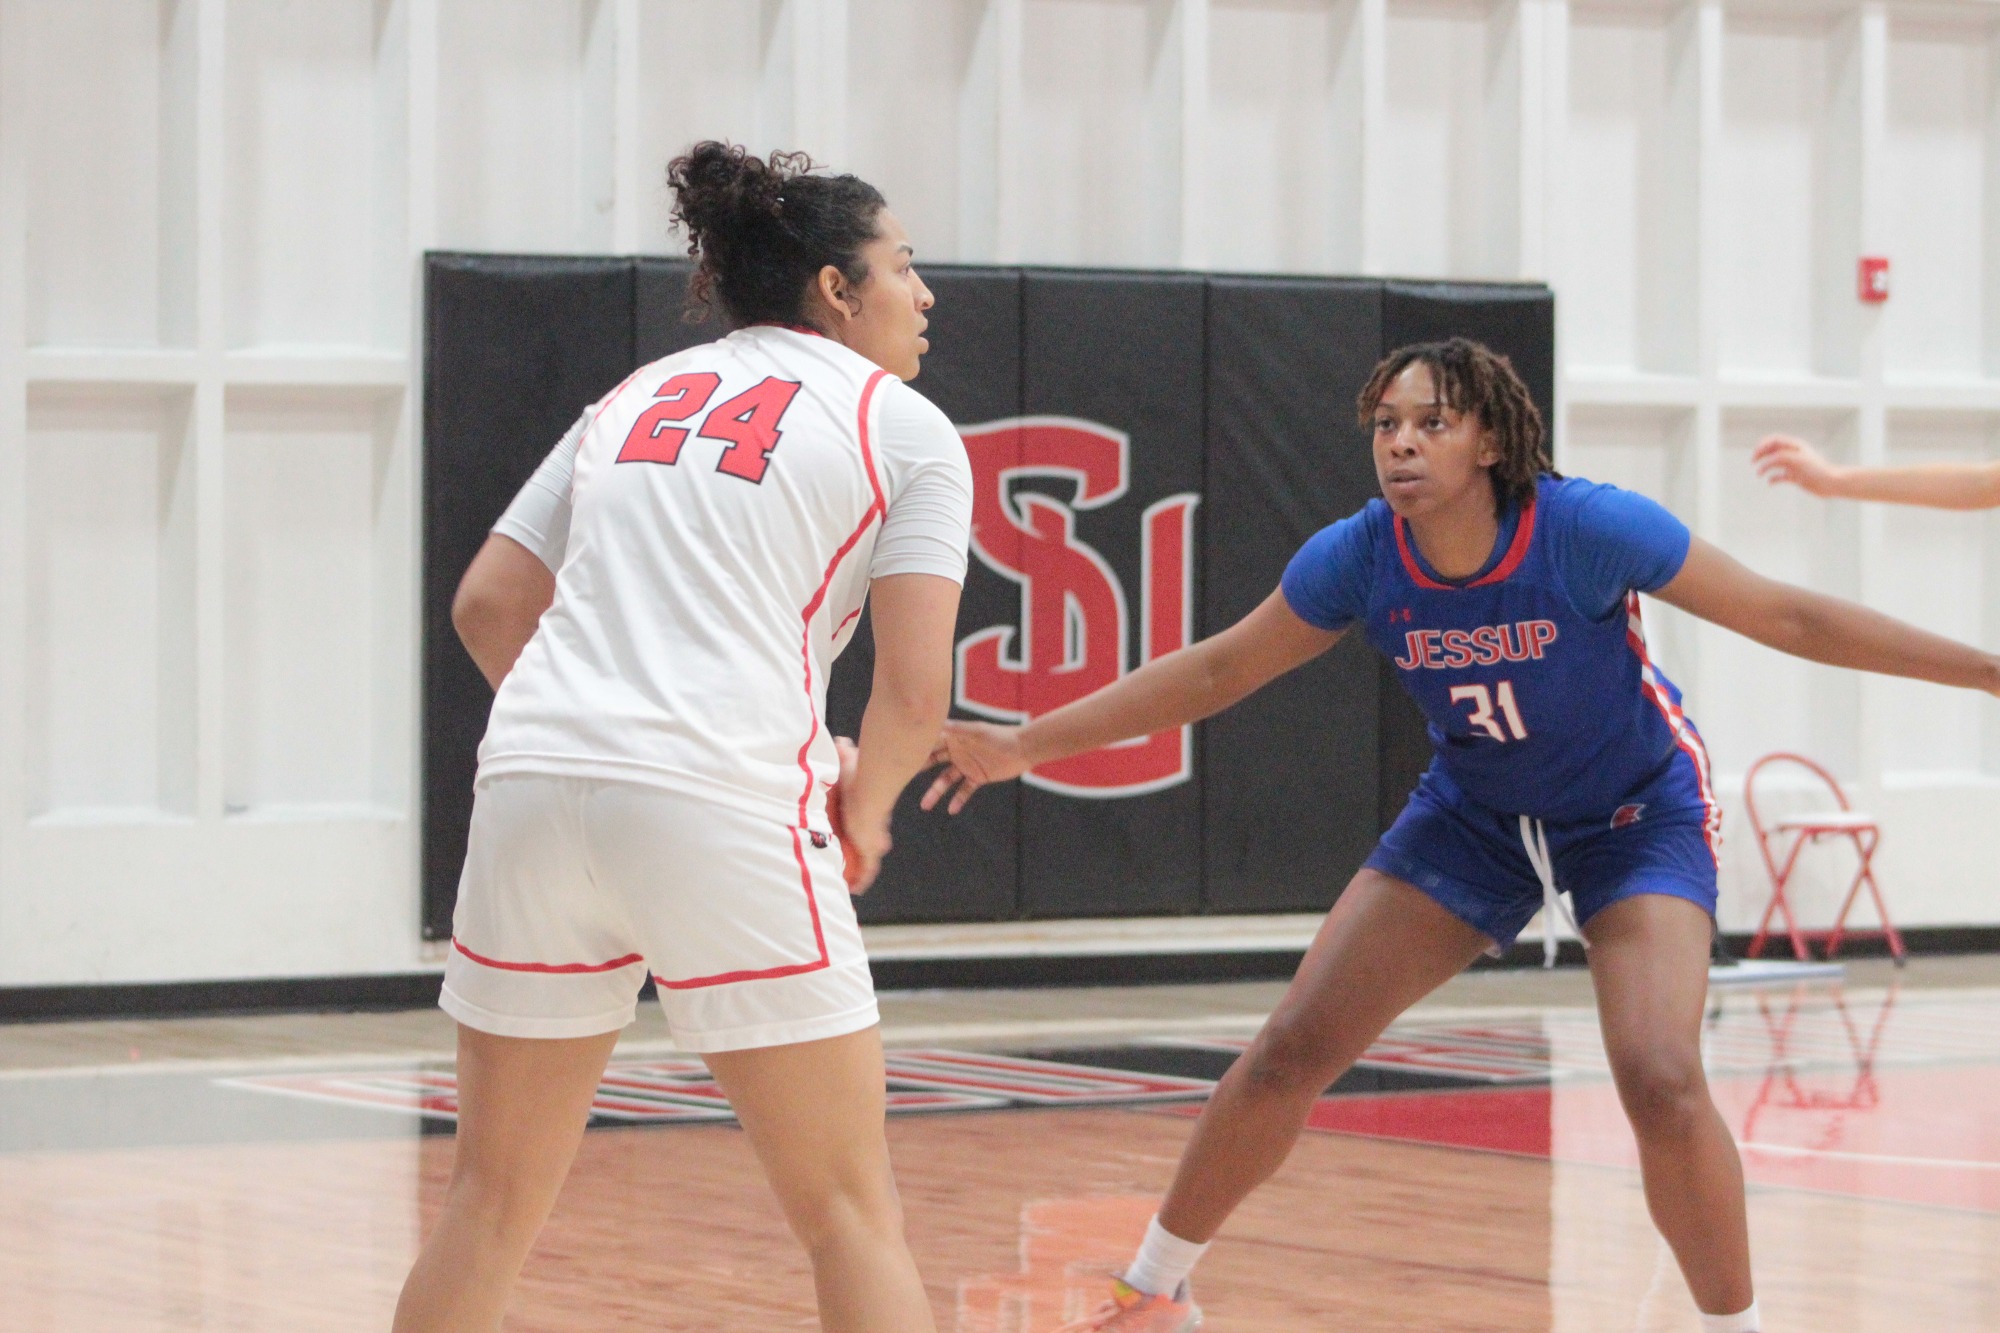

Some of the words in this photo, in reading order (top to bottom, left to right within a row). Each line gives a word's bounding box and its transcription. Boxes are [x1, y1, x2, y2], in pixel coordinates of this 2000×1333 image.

[614, 371, 803, 485] 24
[955, 415, 1201, 799] SU
[1394, 619, 1557, 670] JESSUP
[1450, 679, 1528, 742] 31
